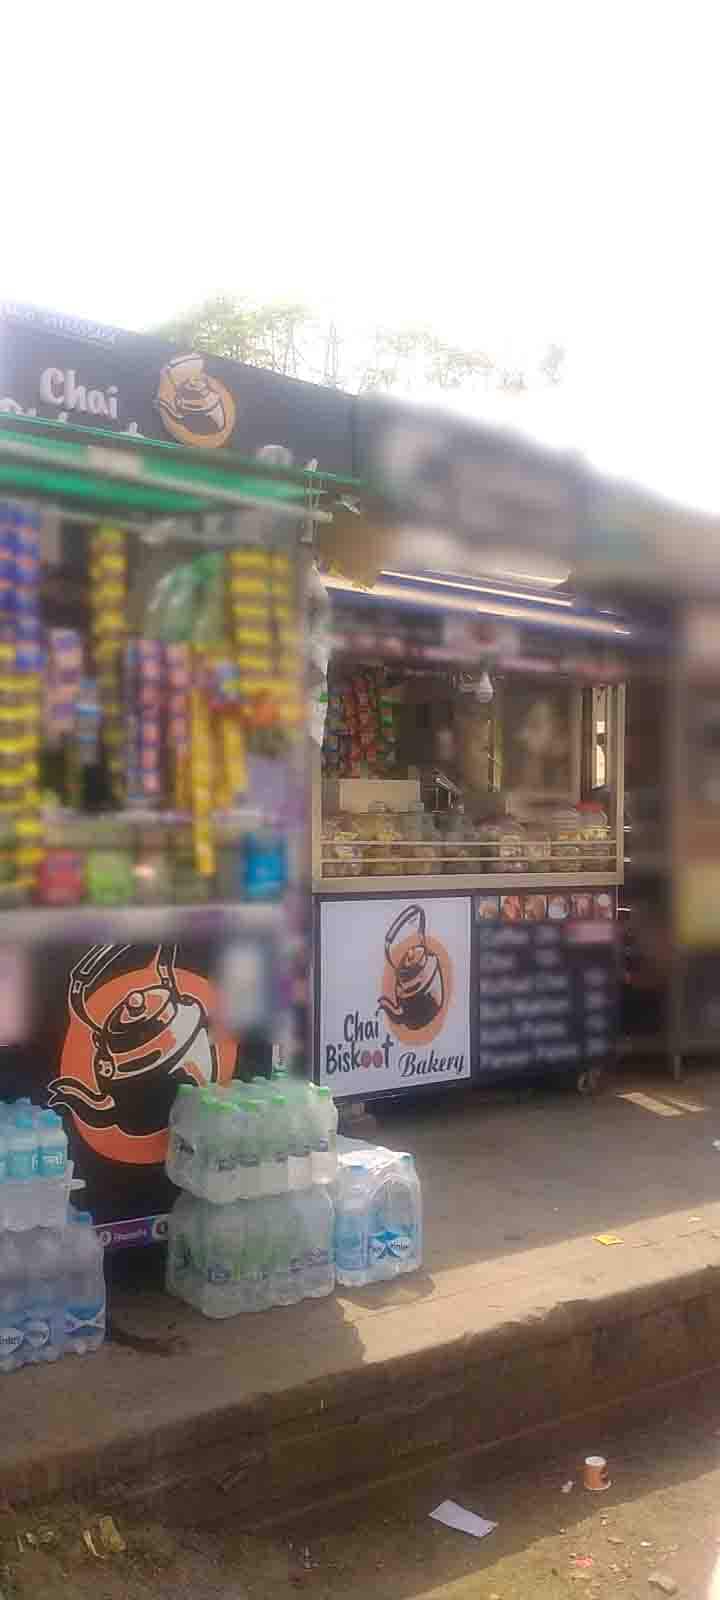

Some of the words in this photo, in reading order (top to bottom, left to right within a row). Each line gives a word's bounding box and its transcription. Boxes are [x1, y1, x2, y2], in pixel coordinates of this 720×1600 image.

[39, 366, 119, 419] Chai
[343, 1009, 380, 1042] Chai
[325, 1034, 394, 1074] Biskoot
[398, 1049, 465, 1078] Bakery
